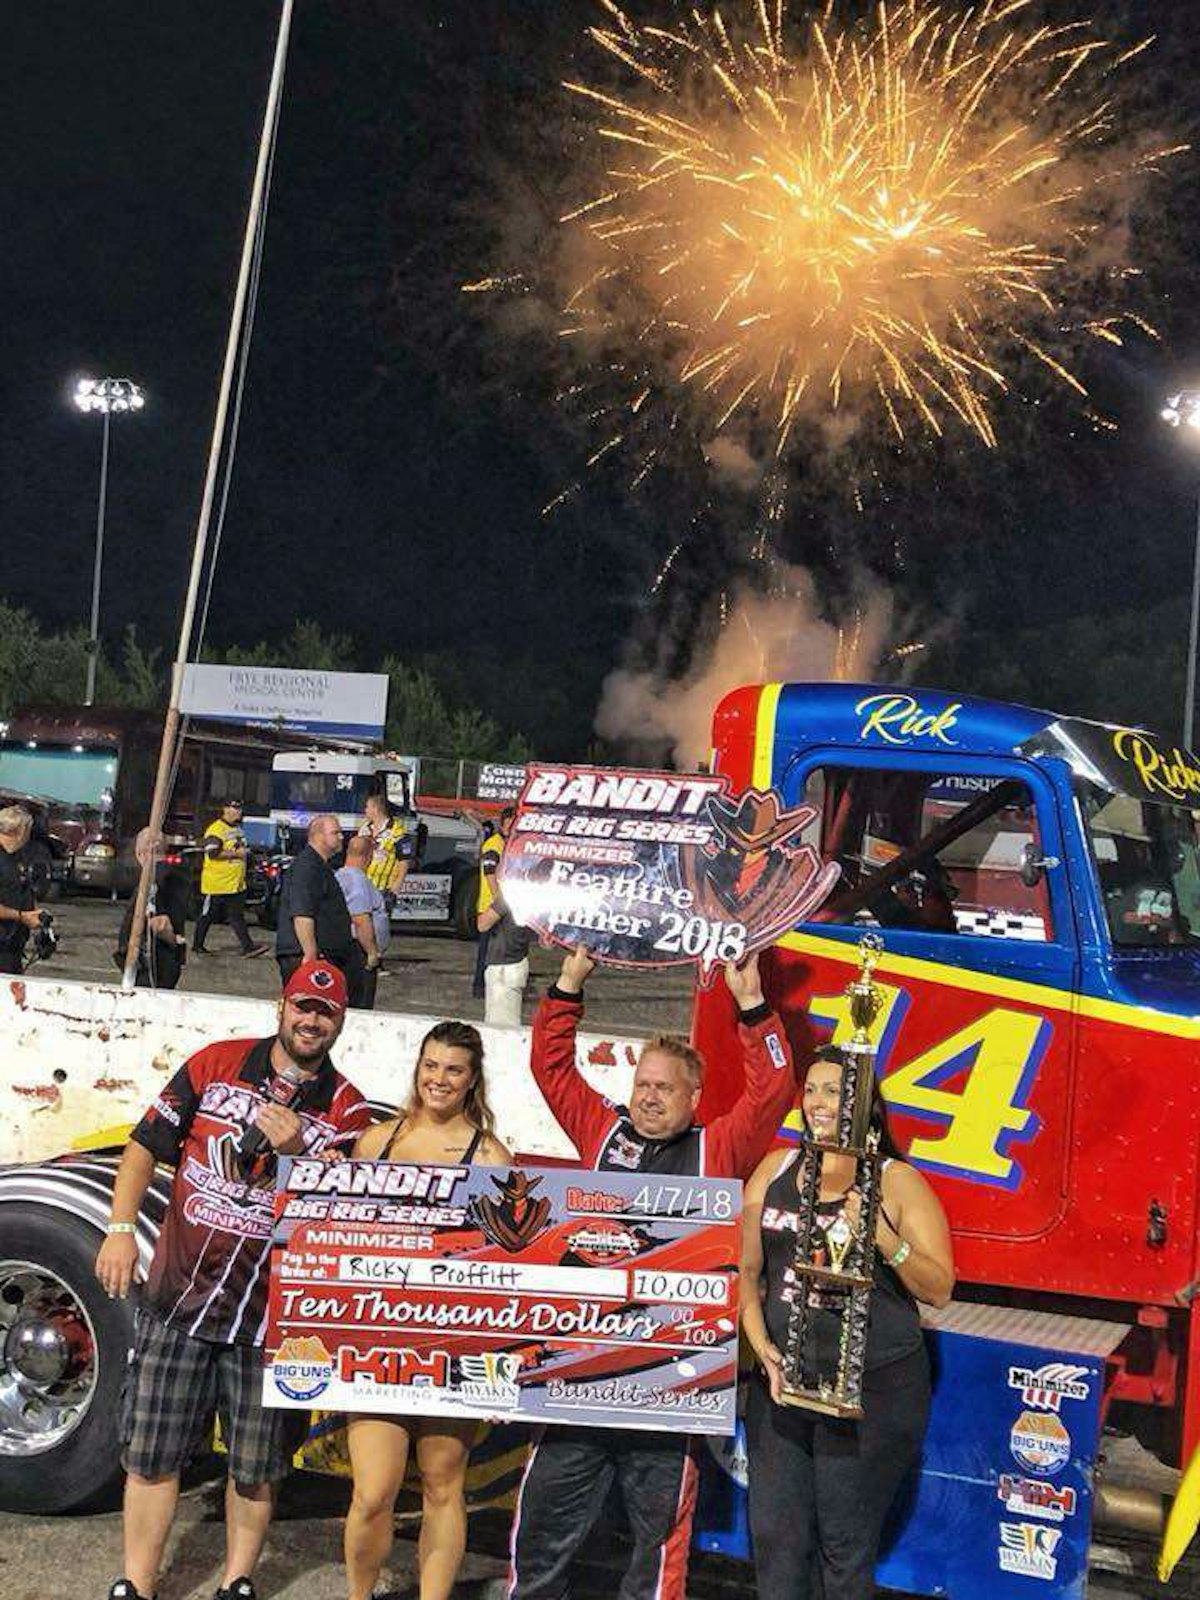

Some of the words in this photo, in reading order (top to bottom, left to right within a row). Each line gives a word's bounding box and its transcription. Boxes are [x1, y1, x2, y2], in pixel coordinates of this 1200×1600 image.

[854, 694, 962, 745] Rick
[524, 771, 721, 815] BANDIT
[517, 812, 566, 834] BIG
[566, 815, 617, 838] RIG
[615, 820, 714, 844] SERIES
[523, 841, 635, 862] MINIMIZER
[551, 859, 695, 909] Feature
[653, 912, 749, 972] 2018
[287, 1159, 468, 1199] BANDIT
[282, 1199, 330, 1219] BIG
[331, 1201, 379, 1223] RIG
[378, 1206, 467, 1227] SERIES
[633, 1185, 732, 1219] 4/7/18
[305, 1230, 434, 1251] MINIMIZER
[636, 1275, 727, 1300] 10,000
[281, 1290, 348, 1320] Ten
[353, 1290, 527, 1329] Thousand
[529, 1302, 662, 1339] Dollars
[683, 1328, 718, 1345] 100
[353, 1386, 432, 1400] MARKETING
[546, 1378, 643, 1405] Bandit
[641, 1386, 727, 1412] Series
[1012, 1370, 1087, 1397] Minimizer
